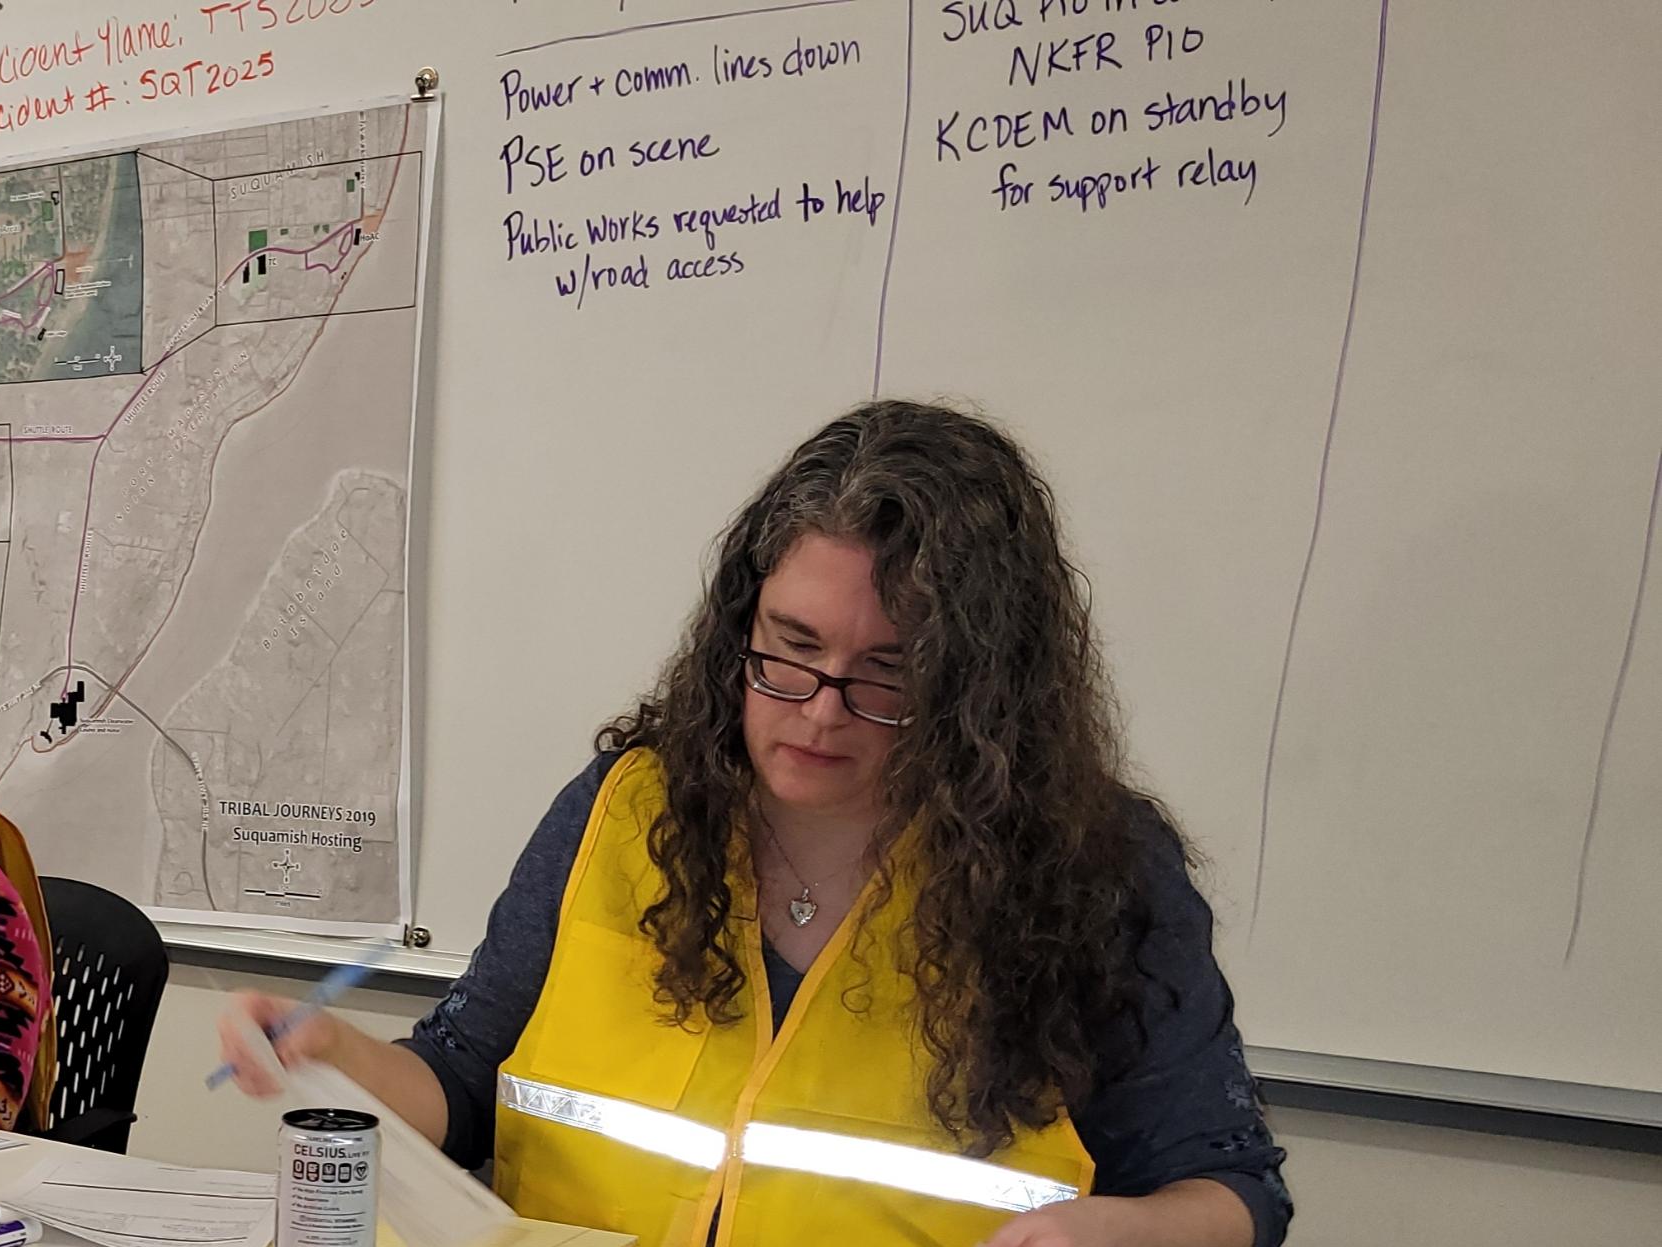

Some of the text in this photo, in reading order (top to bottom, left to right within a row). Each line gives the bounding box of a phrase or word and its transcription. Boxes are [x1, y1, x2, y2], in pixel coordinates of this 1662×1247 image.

[139, 51, 274, 101] SQT2025
[501, 36, 861, 120] Power + comm. lines down
[1008, 32, 1123, 88] NKFR
[935, 79, 1288, 162] KCDEM on standby
[230, 151, 326, 200] SUQUAMISH
[501, 131, 721, 194] PSE on scene
[990, 155, 1259, 213] for support relay
[503, 210, 579, 261] Public
[673, 188, 781, 251] requested
[795, 182, 825, 223] to
[835, 175, 886, 227] help
[555, 251, 745, 310] w/road access
[219, 801, 376, 827] TRIBAL JOURNEYS 2019
[233, 827, 362, 853] Suquamish Hosting
